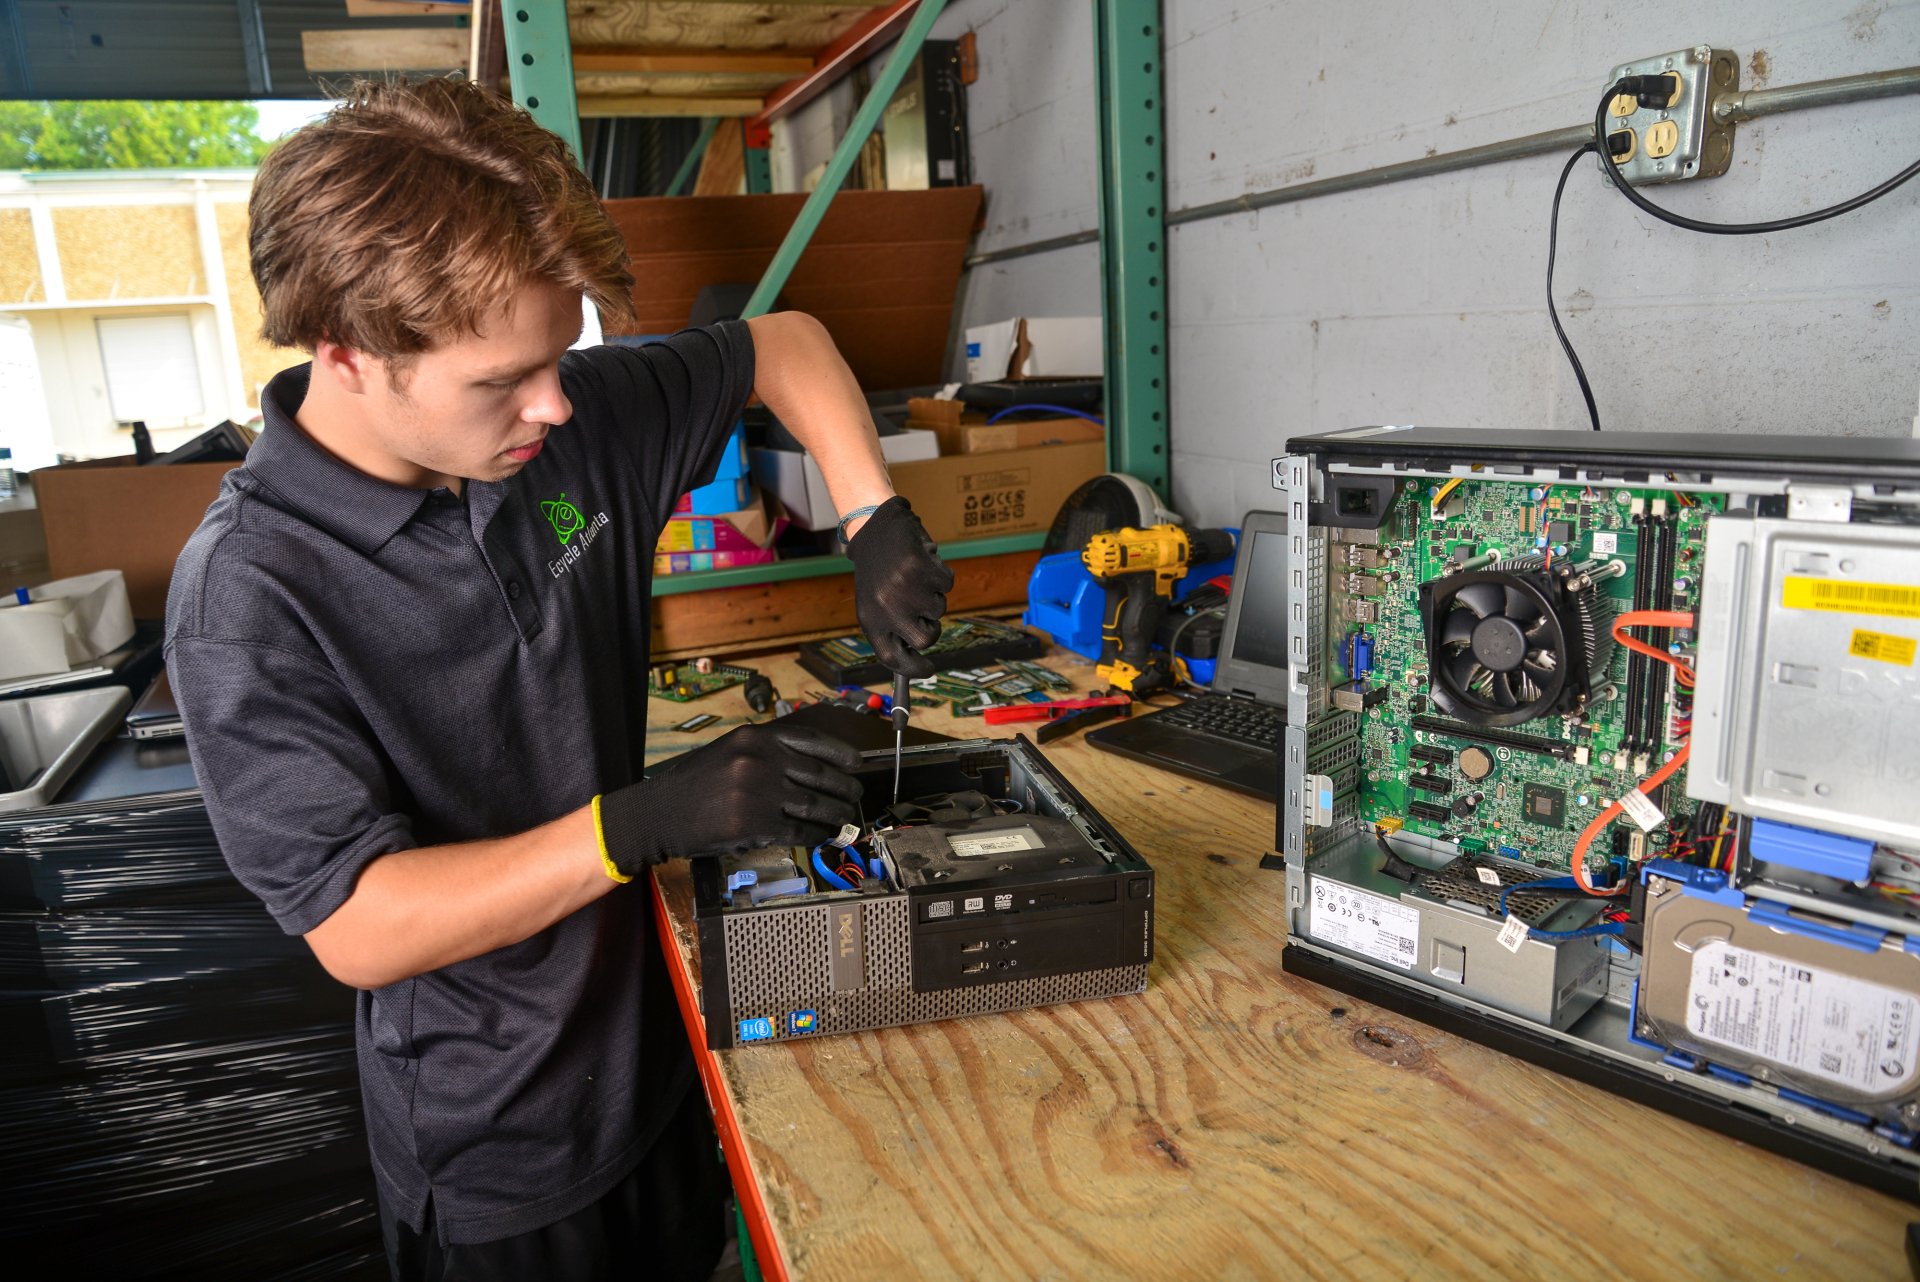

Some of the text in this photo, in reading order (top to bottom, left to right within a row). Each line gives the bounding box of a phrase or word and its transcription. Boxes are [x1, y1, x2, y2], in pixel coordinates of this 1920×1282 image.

[548, 511, 609, 578] Ecycle Atlanta
[838, 913, 855, 958] DELL
[1698, 1011, 1706, 1033] Seagate
